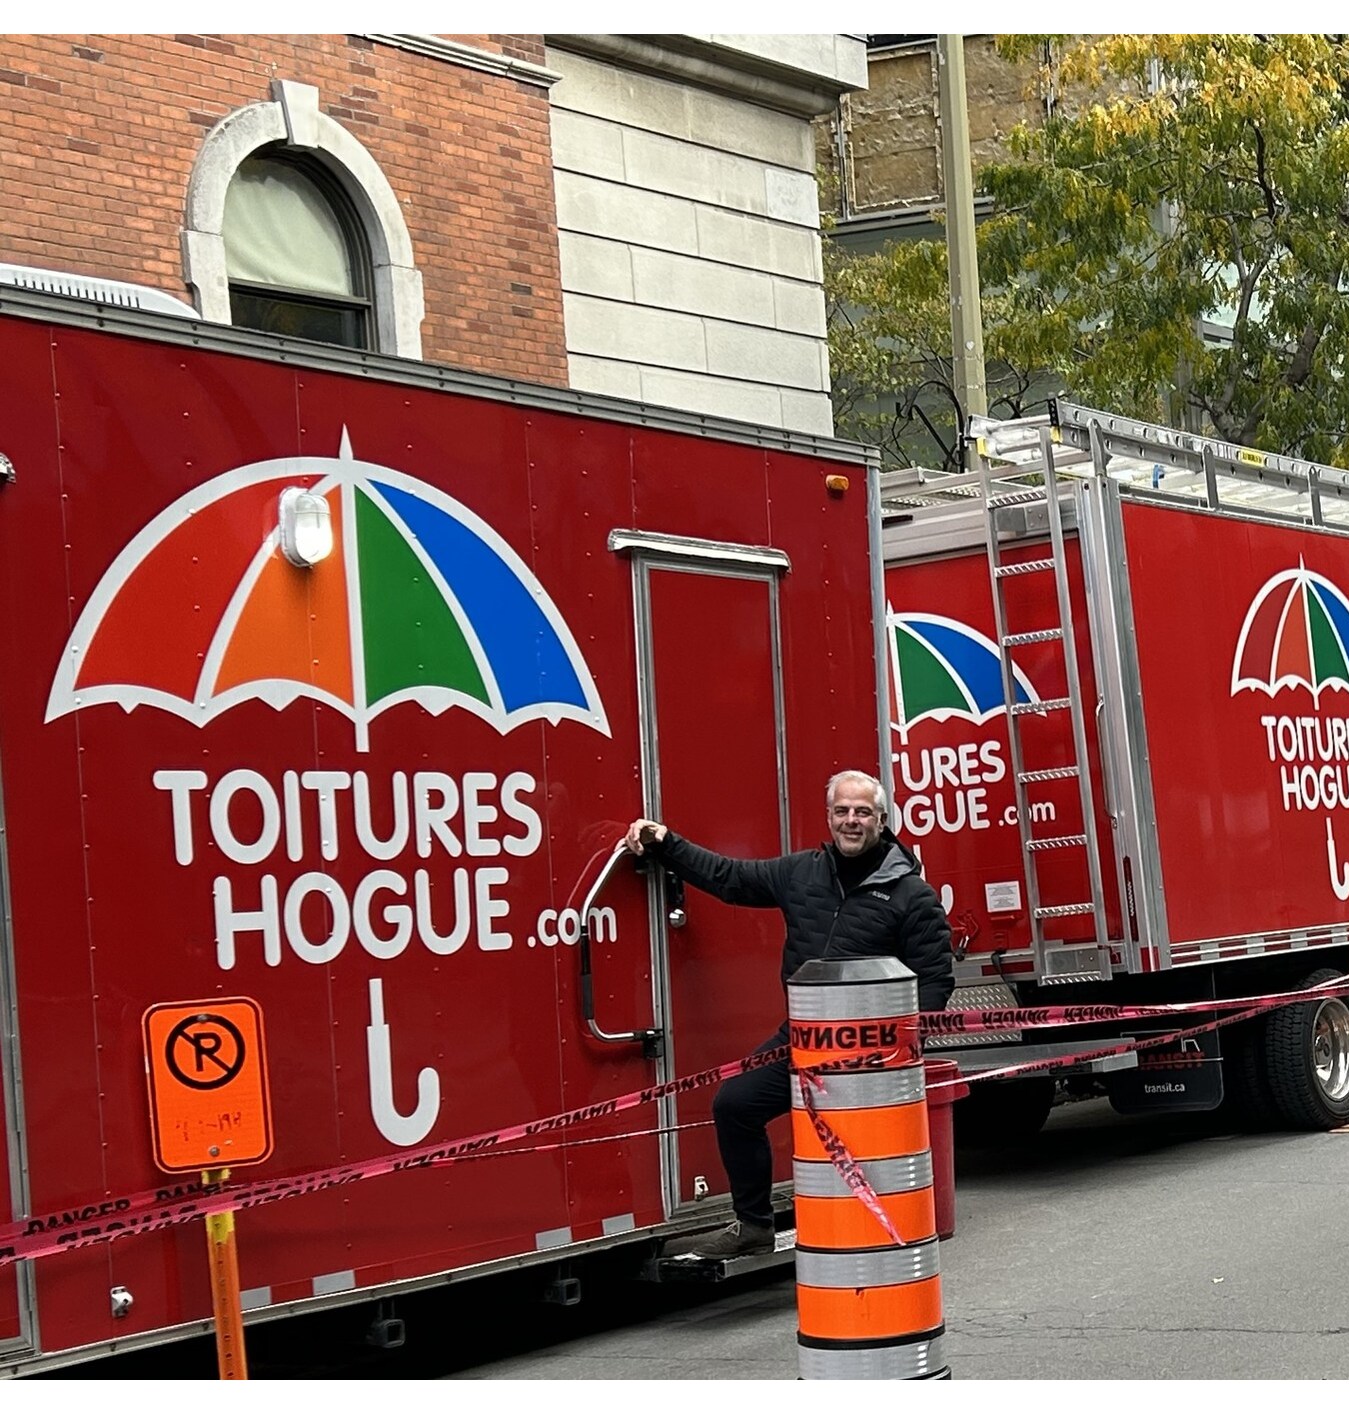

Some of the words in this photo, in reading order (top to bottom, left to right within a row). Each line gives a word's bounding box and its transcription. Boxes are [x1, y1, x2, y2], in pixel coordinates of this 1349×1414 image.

[153, 769, 542, 866] TOITURES
[213, 867, 513, 970] HOGUE
[527, 906, 618, 948] .com
[981, 1009, 1049, 1030] DANGER
[1144, 1082, 1185, 1094] transit.ca
